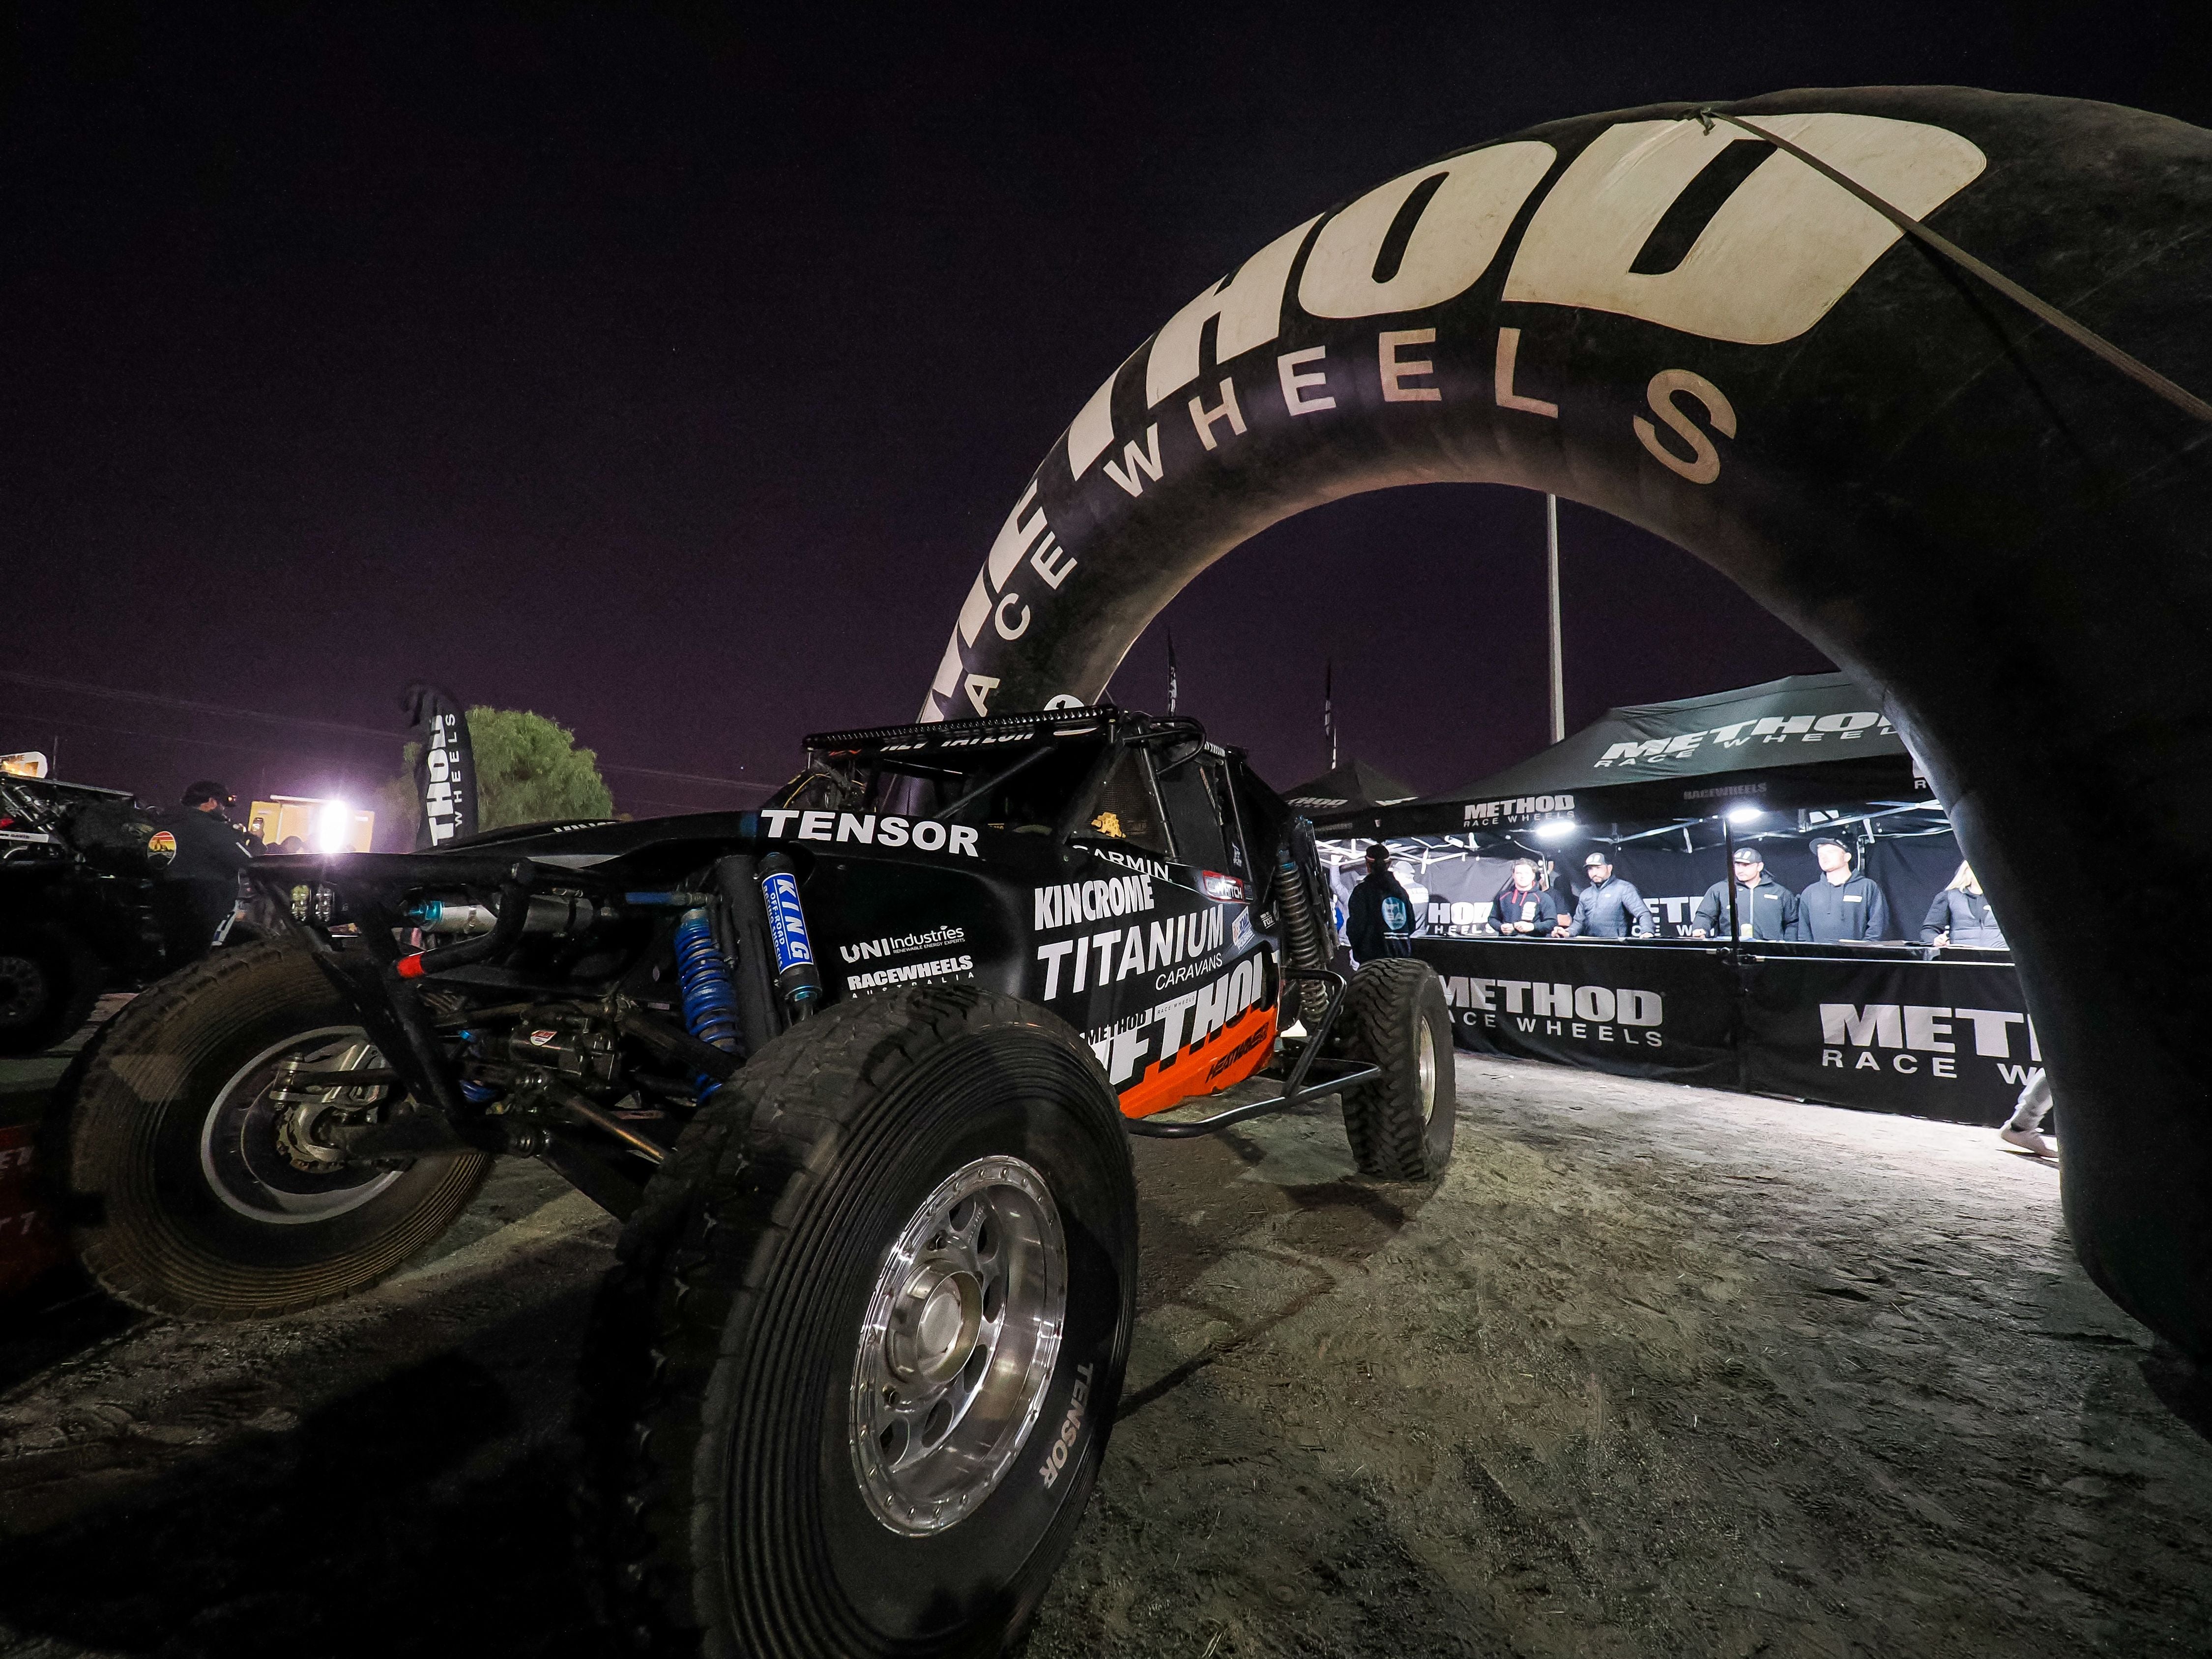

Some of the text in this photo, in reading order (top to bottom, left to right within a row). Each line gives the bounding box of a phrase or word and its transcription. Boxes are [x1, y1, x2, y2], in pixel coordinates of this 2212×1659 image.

[964, 326, 1737, 718] ACE WHEELS
[1593, 729, 1899, 768] RACE WHEEL
[1600, 711, 1892, 760] METHO
[445, 713, 463, 827] WHEELS
[1463, 811, 1575, 828] RACE WHEELS
[1464, 794, 1575, 820] METHOD
[760, 810, 979, 857] TENSOR
[1072, 844, 1169, 882] ARMIN
[770, 892, 786, 945] OFF-ROAD
[777, 878, 810, 960] KING
[1034, 874, 1155, 931] KINCROME
[763, 885, 783, 968] RACING SHOCKS
[840, 925, 965, 964] UNI Industries
[893, 945, 923, 954] RENEWABLE
[944, 937, 965, 946] EXPERTS
[1425, 922, 1495, 935] HEELS
[1037, 903, 1223, 1001] TITANIUM
[1155, 952, 1223, 991] CARAVANS
[847, 955, 974, 991] RACEWHEELS
[1157, 994, 1196, 1016] RACE WHEELS
[1438, 974, 1663, 1027] METHOD
[1085, 1010, 1147, 1046] METHOD
[1448, 1010, 1663, 1048] CE WHEELS
[1819, 1003, 2042, 1062] MET
[1821, 1048, 1958, 1079] RACE
[1038, 1362, 1094, 1489] TENSOR
